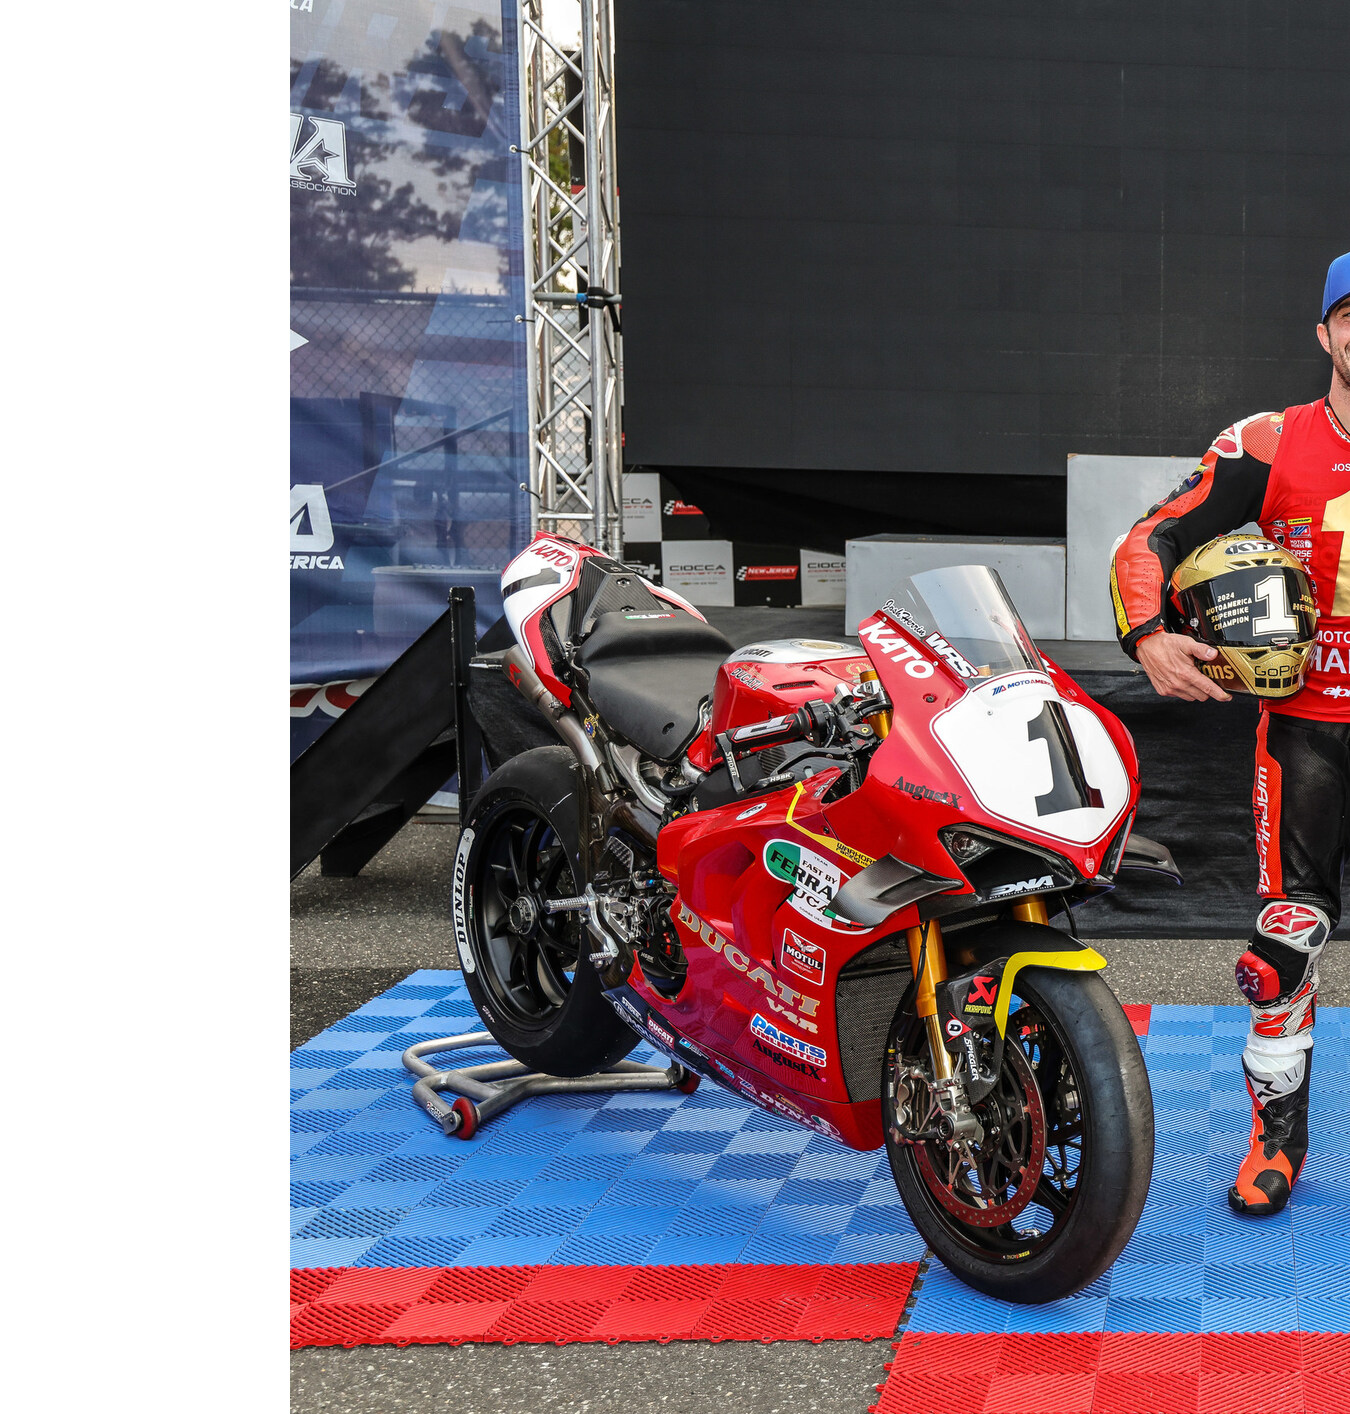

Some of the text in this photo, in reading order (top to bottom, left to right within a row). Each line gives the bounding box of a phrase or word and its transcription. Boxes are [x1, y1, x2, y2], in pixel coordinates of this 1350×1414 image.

[290, 181, 357, 197] SSOCIATION
[531, 544, 573, 567] KATO
[1211, 606, 1249, 623] SUPERBIKE
[1217, 592, 1235, 603] 2024
[1252, 575, 1300, 637] 1
[882, 599, 926, 637] Josh Herrin
[1214, 615, 1250, 632] CHAMPION
[859, 621, 935, 679] KATO
[924, 632, 978, 678] WRS
[730, 667, 764, 690] DUCATI
[1254, 664, 1300, 677] GoPro
[725, 750, 739, 777] SPIDER
[1027, 700, 1104, 817] 1
[891, 776, 963, 810] AugustX
[802, 859, 838, 885] FAST BY
[990, 875, 1054, 896] DNA
[453, 852, 465, 945] DUNLOP
[677, 902, 821, 1018] DUCATI
[785, 946, 821, 970] MOTUL
[648, 1019, 674, 1043] DUCATI
[766, 997, 819, 1034] V4R
[751, 1026, 826, 1068] UNLIMITED
[752, 1013, 826, 1060] PARTS
[752, 1039, 823, 1081] AugustX
[964, 1037, 979, 1082] SPIEGLER
